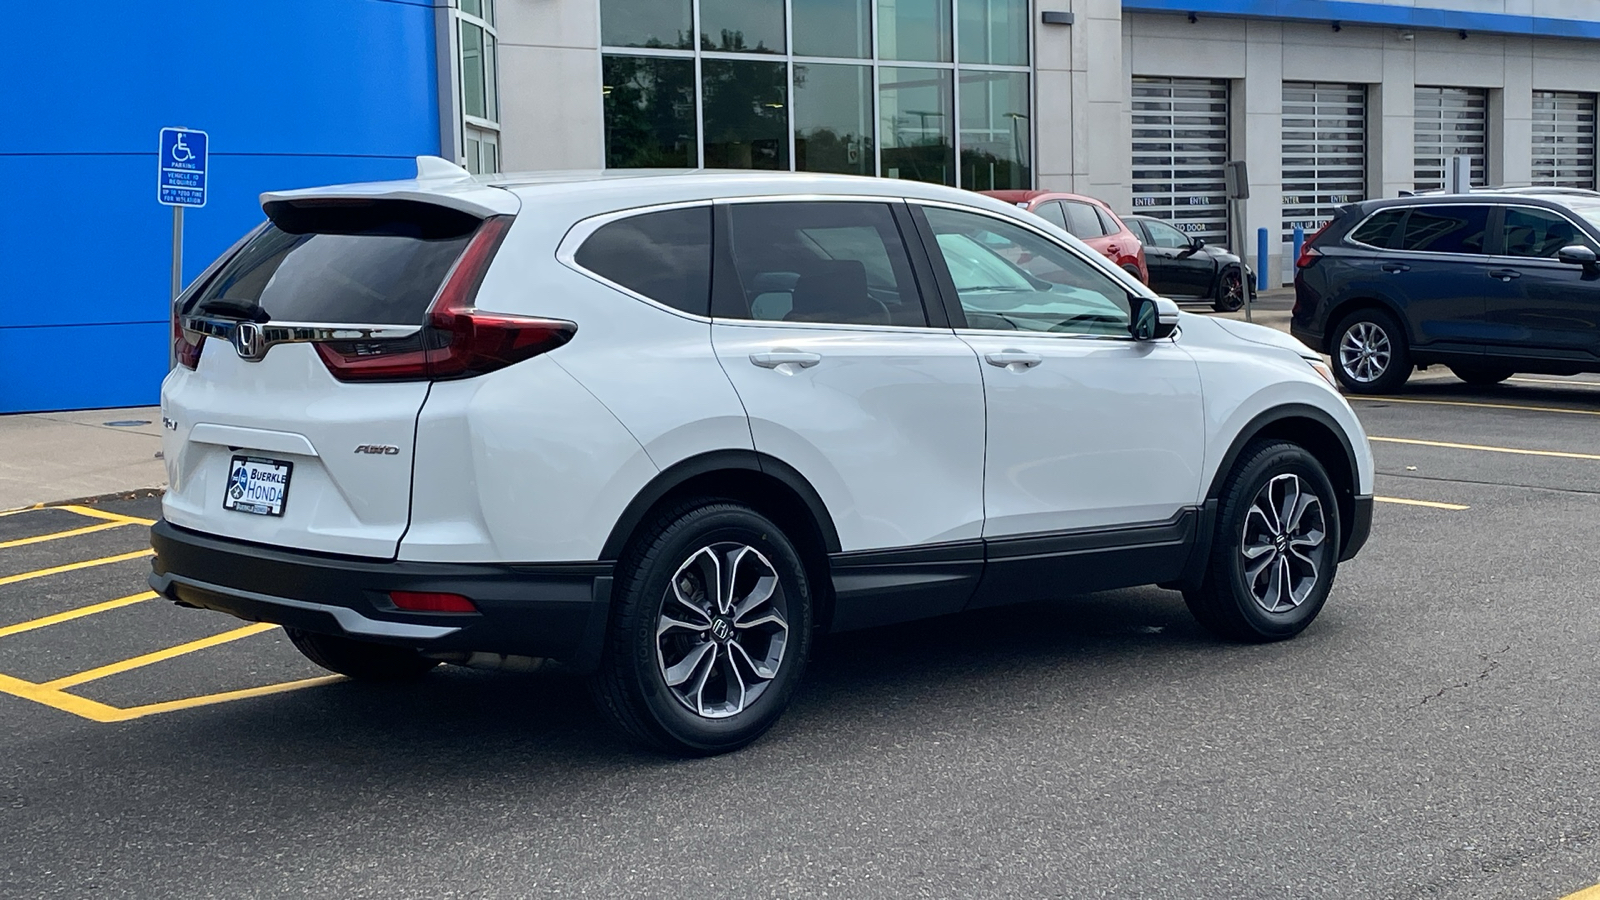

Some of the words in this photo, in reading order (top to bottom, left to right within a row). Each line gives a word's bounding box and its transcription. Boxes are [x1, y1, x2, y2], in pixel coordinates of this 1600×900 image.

[1135, 197, 1156, 206] ENTER
[1189, 196, 1209, 205] ENTER
[1330, 195, 1349, 203] ENTER
[1186, 223, 1206, 232] DOOR
[1305, 221, 1313, 229] UP
[353, 444, 400, 455] AWD
[250, 468, 287, 484] BUERKLE
[246, 480, 284, 502] HONDA
